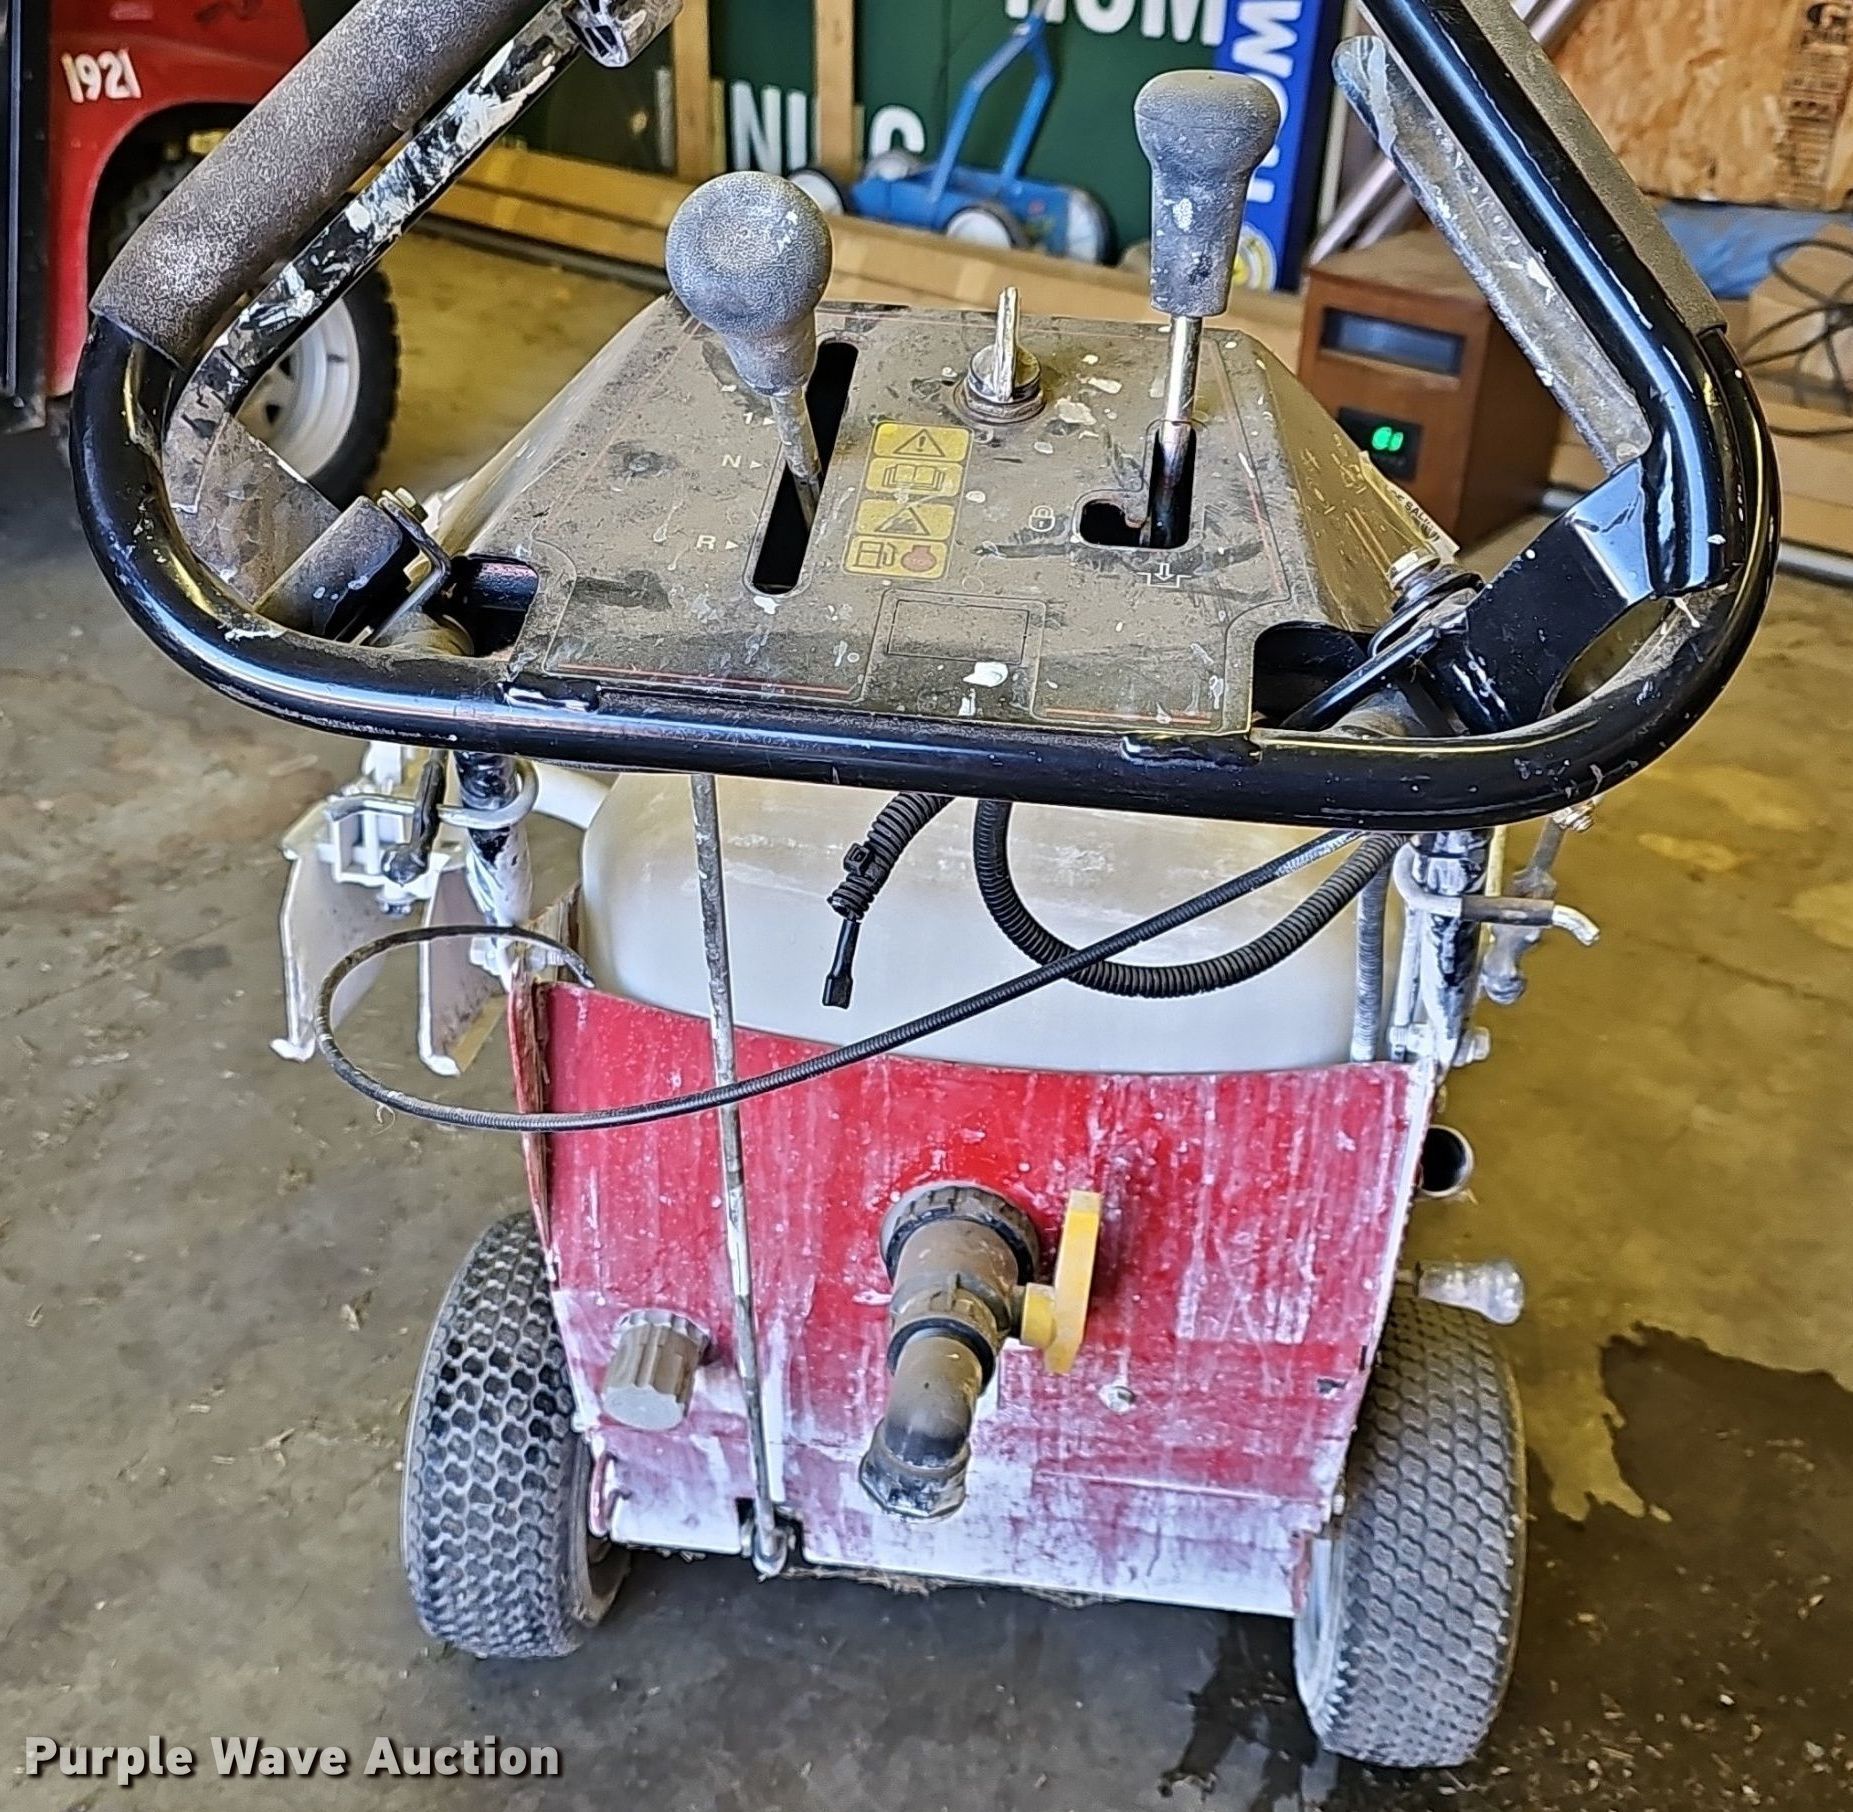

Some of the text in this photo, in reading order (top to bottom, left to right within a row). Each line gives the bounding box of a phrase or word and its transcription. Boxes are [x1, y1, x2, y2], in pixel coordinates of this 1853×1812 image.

[61, 48, 142, 103] 1921
[743, 412, 753, 425] 1
[722, 454, 741, 468] N
[696, 535, 716, 550] R
